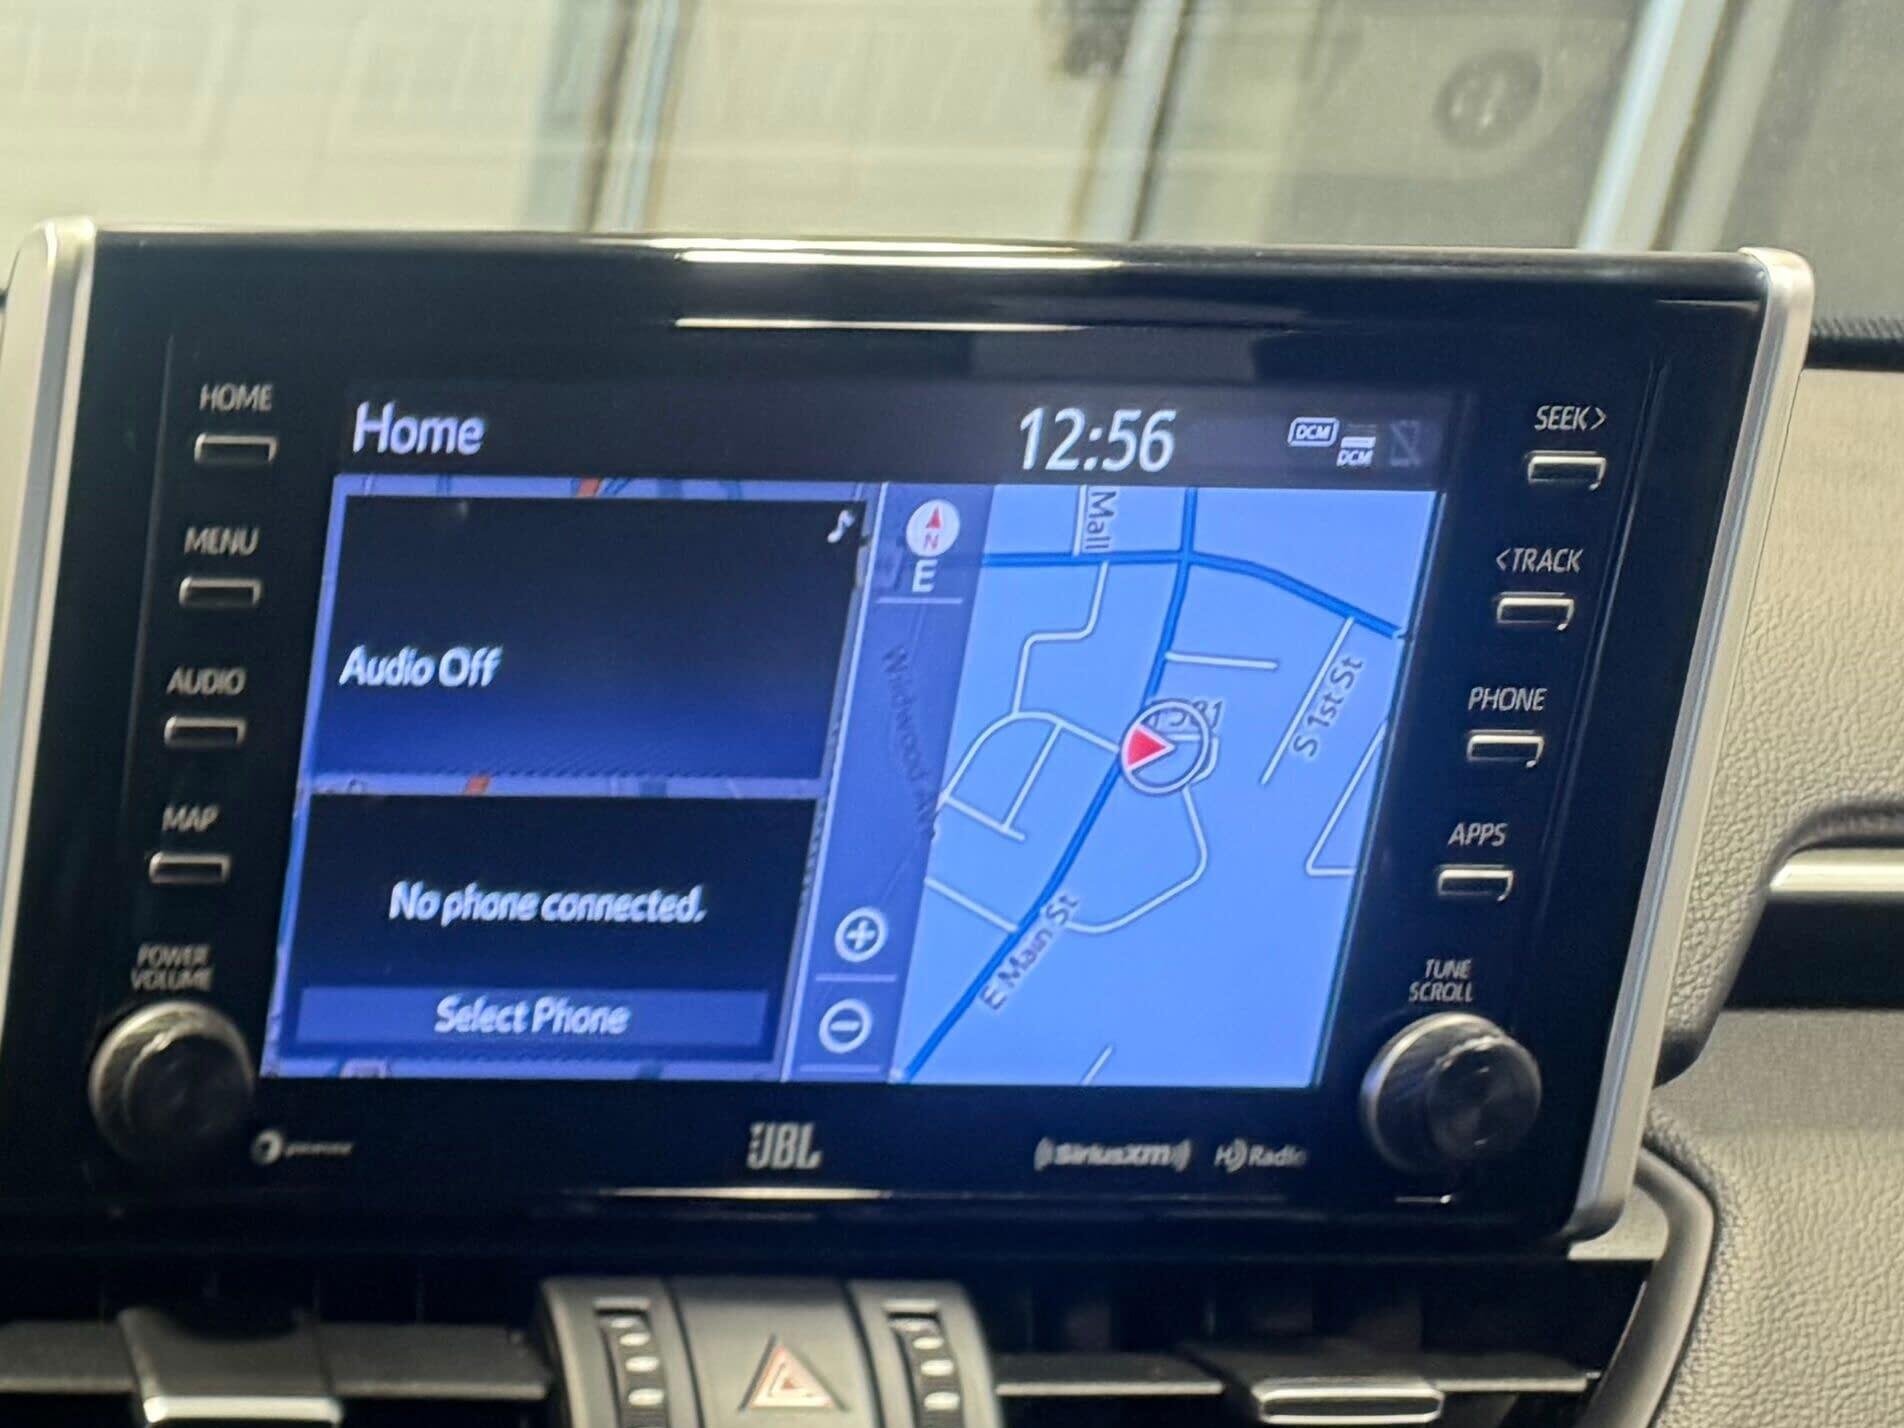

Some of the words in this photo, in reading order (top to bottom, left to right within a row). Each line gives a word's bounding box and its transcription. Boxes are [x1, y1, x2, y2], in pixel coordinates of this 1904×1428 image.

[200, 384, 273, 411] HOME
[352, 400, 485, 455] Home
[1019, 408, 1177, 473] 12:56
[1089, 489, 1117, 553] Mall
[184, 527, 259, 556] MENU
[911, 559, 935, 593] E
[167, 667, 247, 697] AUDIO
[339, 644, 435, 688] Audio
[438, 645, 504, 688] Off
[1307, 692, 1345, 728] 1st
[1329, 656, 1364, 690] St
[1468, 685, 1547, 712] PHONE
[163, 805, 219, 833] MAP
[1448, 822, 1507, 847] APPS
[389, 881, 438, 922] No
[441, 881, 539, 928] phone
[541, 884, 709, 925] connected.
[997, 927, 1053, 988] Main
[1046, 895, 1079, 925] St
[1424, 958, 1472, 980] TUNE
[1408, 980, 1474, 1003] SCROLL
[434, 995, 530, 1036] Select
[532, 996, 631, 1037] Phone
[746, 1121, 823, 1170] JBL
